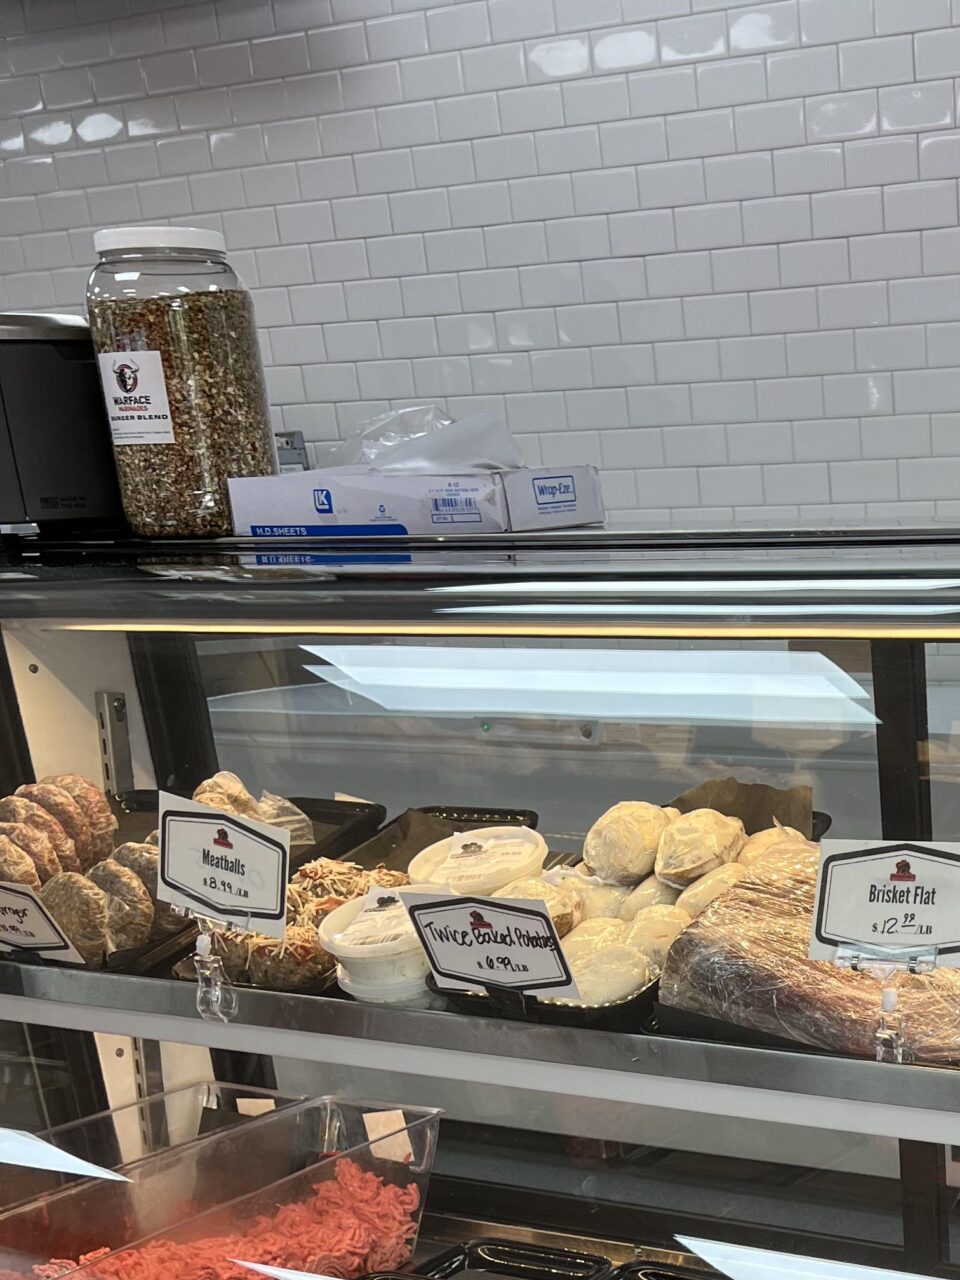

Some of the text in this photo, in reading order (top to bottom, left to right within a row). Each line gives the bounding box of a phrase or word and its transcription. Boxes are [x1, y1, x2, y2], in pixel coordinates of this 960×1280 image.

[112, 396, 151, 406] WARFACE
[202, 848, 246, 876] Meatballs
[868, 884, 937, 906] Brisket Flat
[424, 921, 473, 947] Twice
[472, 926, 516, 947] Baked
